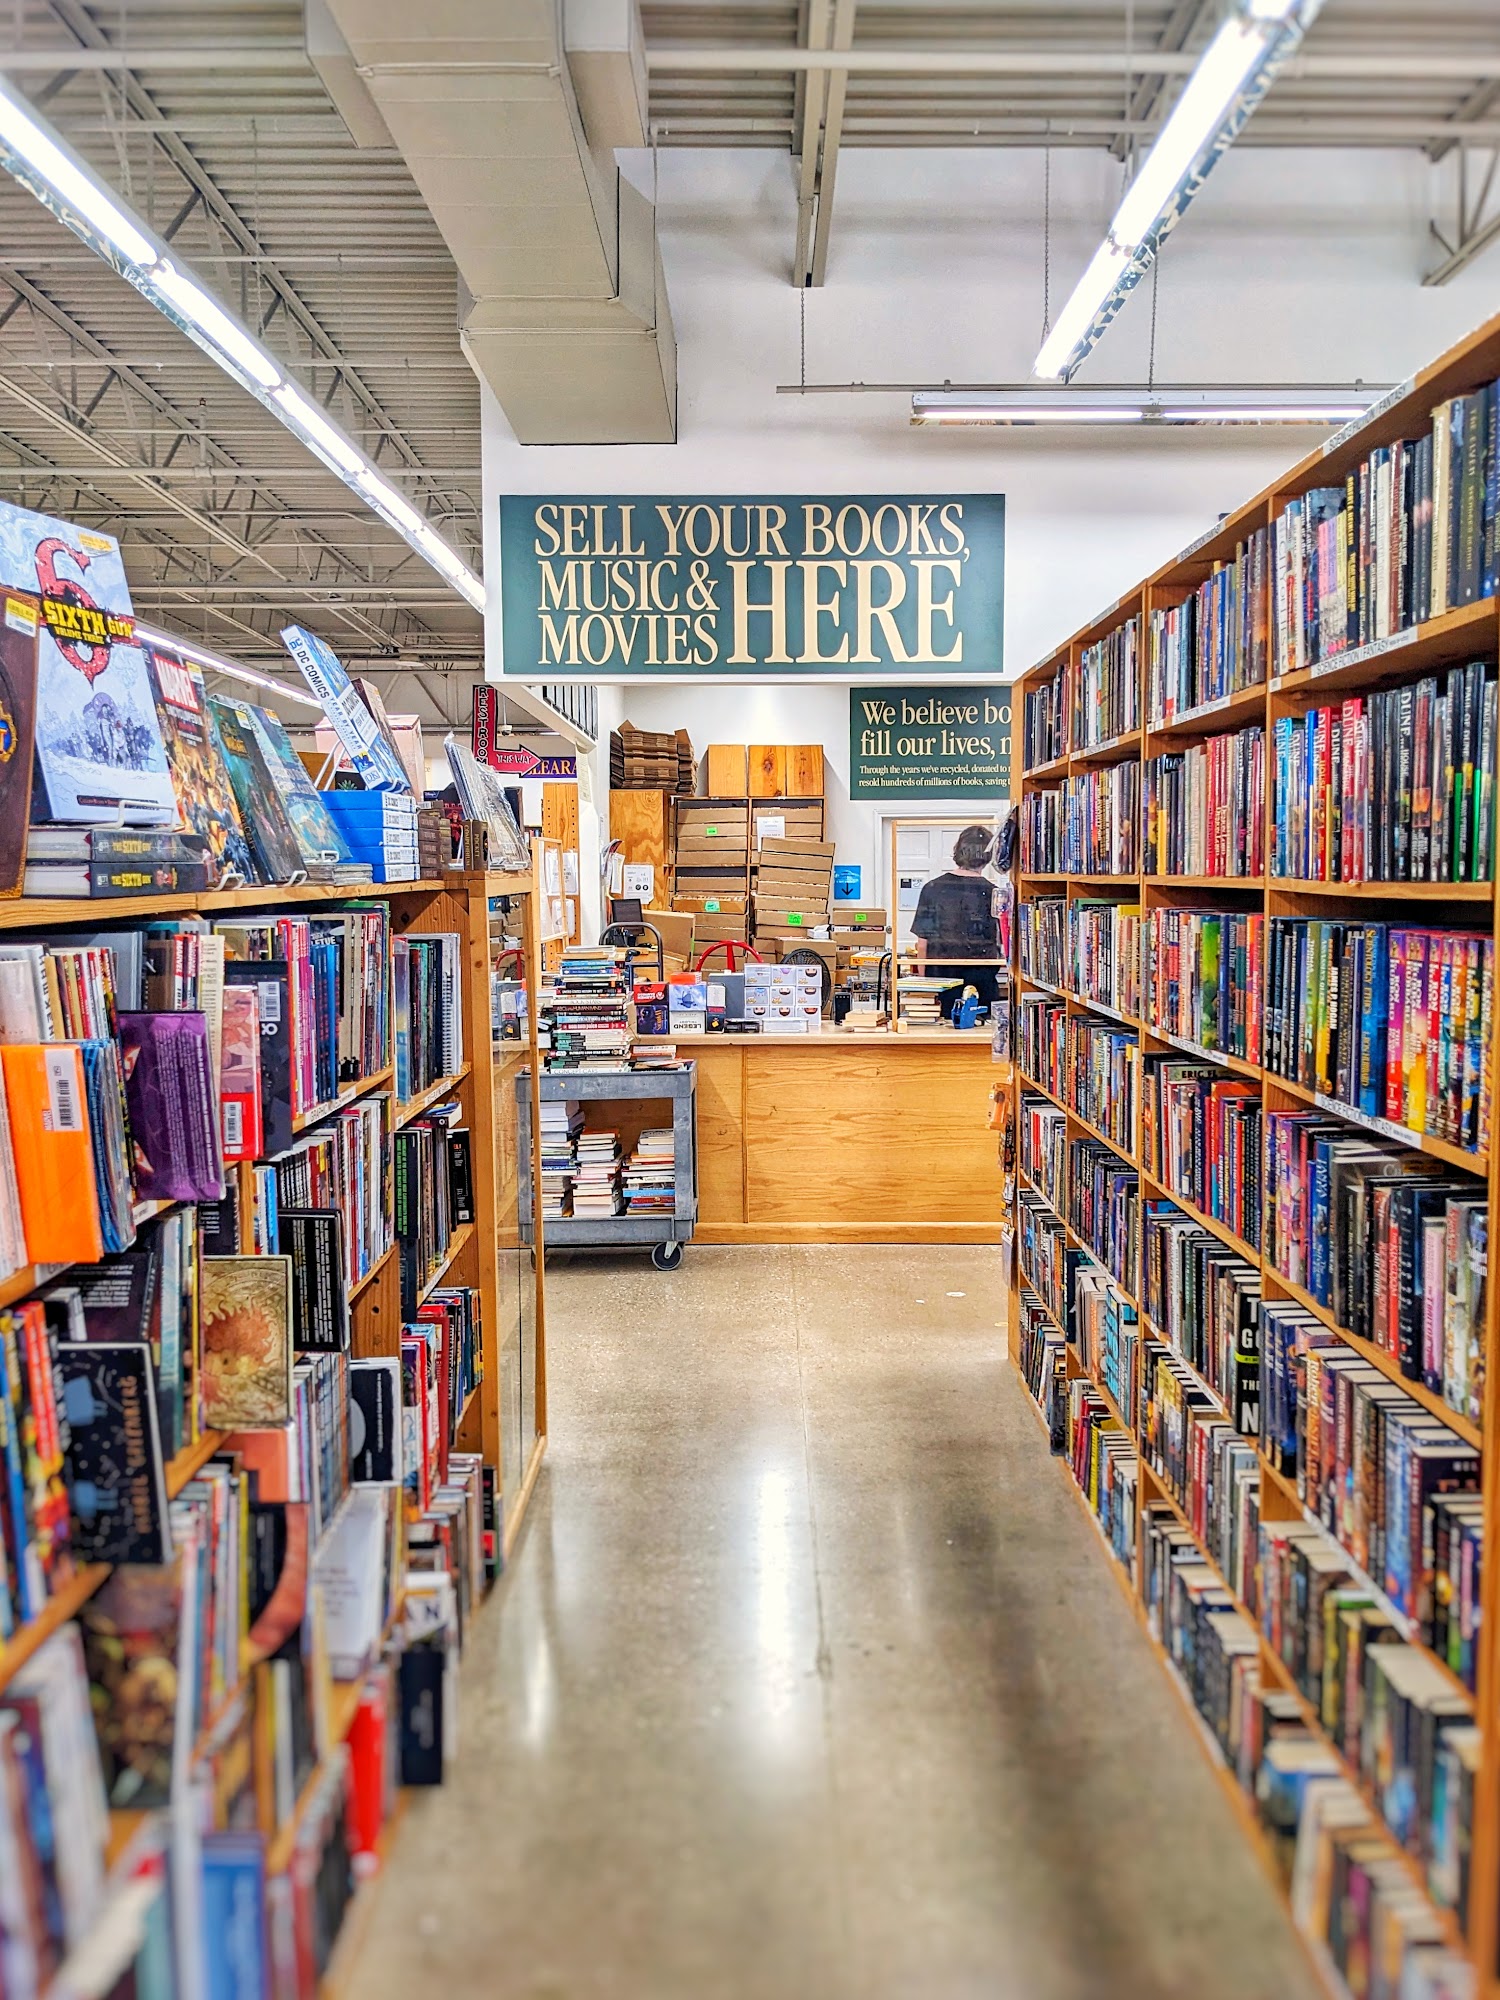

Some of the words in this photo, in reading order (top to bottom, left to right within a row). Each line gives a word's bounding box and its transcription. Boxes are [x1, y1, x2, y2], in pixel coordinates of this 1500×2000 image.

[1469, 408, 1477, 431] THE
[1468, 436, 1476, 476] ELVEN
[535, 504, 645, 557] SELL
[655, 504, 791, 557] YOUR
[802, 503, 971, 563] BOOKS,
[538, 560, 679, 612] MUSIC
[686, 559, 720, 612] &
[43, 600, 107, 636] SIXTH
[106, 618, 134, 639] GUN
[726, 559, 963, 664] HERE
[289, 638, 303, 649] DC
[538, 614, 719, 666] MOVIES
[1317, 656, 1340, 675] SCIENCE
[1363, 641, 1388, 659] FANTASY
[155, 657, 199, 710] MARVEL
[296, 650, 310, 664] DC
[304, 664, 330, 699] COMICS
[329, 697, 343, 718] YEAR
[342, 718, 350, 729] BY
[349, 729, 363, 750] YEAR
[861, 700, 896, 726] We
[901, 698, 978, 726] believe
[1343, 706, 1354, 747] DUNE
[1400, 691, 1411, 736] DUNE
[1446, 720, 1453, 732] OF
[1464, 714, 1471, 727] OF
[1483, 702, 1491, 726] PAUL
[860, 729, 892, 756] fill
[896, 735, 937, 757] our
[940, 729, 996, 761] lives,
[1277, 723, 1287, 759] DUNE
[1318, 713, 1326, 752] DUNE
[1331, 729, 1341, 764] DUNE
[1355, 718, 1364, 757] DUNE
[1482, 727, 1490, 740] OF
[514, 754, 532, 765] WAY
[1293, 734, 1301, 768] DUNE
[1482, 743, 1490, 769] DUNE
[858, 777, 880, 787] resold
[880, 777, 916, 787] hundreds
[916, 777, 924, 786] of
[924, 776, 952, 786] millions
[952, 777, 962, 786] of
[961, 776, 984, 788] books,
[984, 777, 1007, 788] saving
[859, 765, 889, 776] Through
[889, 765, 901, 774] the
[902, 767, 921, 775] years
[920, 765, 939, 774] we've
[940, 764, 971, 776] recycled,
[971, 764, 999, 774] donated
[999, 765, 1007, 774] to
[1318, 759, 1326, 792] HOUSE
[122, 840, 143, 854] SIXTH
[121, 873, 142, 887] SIXTH
[175, 939, 184, 977] MARVEL
[1319, 938, 1327, 981] ASSASSIN'S
[1363, 929, 1376, 983] SCIENTOLOGY
[1330, 966, 1339, 994] JAMES
[1329, 1001, 1338, 1030] HOGAN
[1363, 986, 1373, 1015] ETHICS
[1181, 1070, 1203, 1079] ERIC
[1361, 1053, 1370, 1086] HUBBARD
[1390, 1242, 1398, 1297] KINGDOM
[1310, 1360, 1319, 1406] Robert
